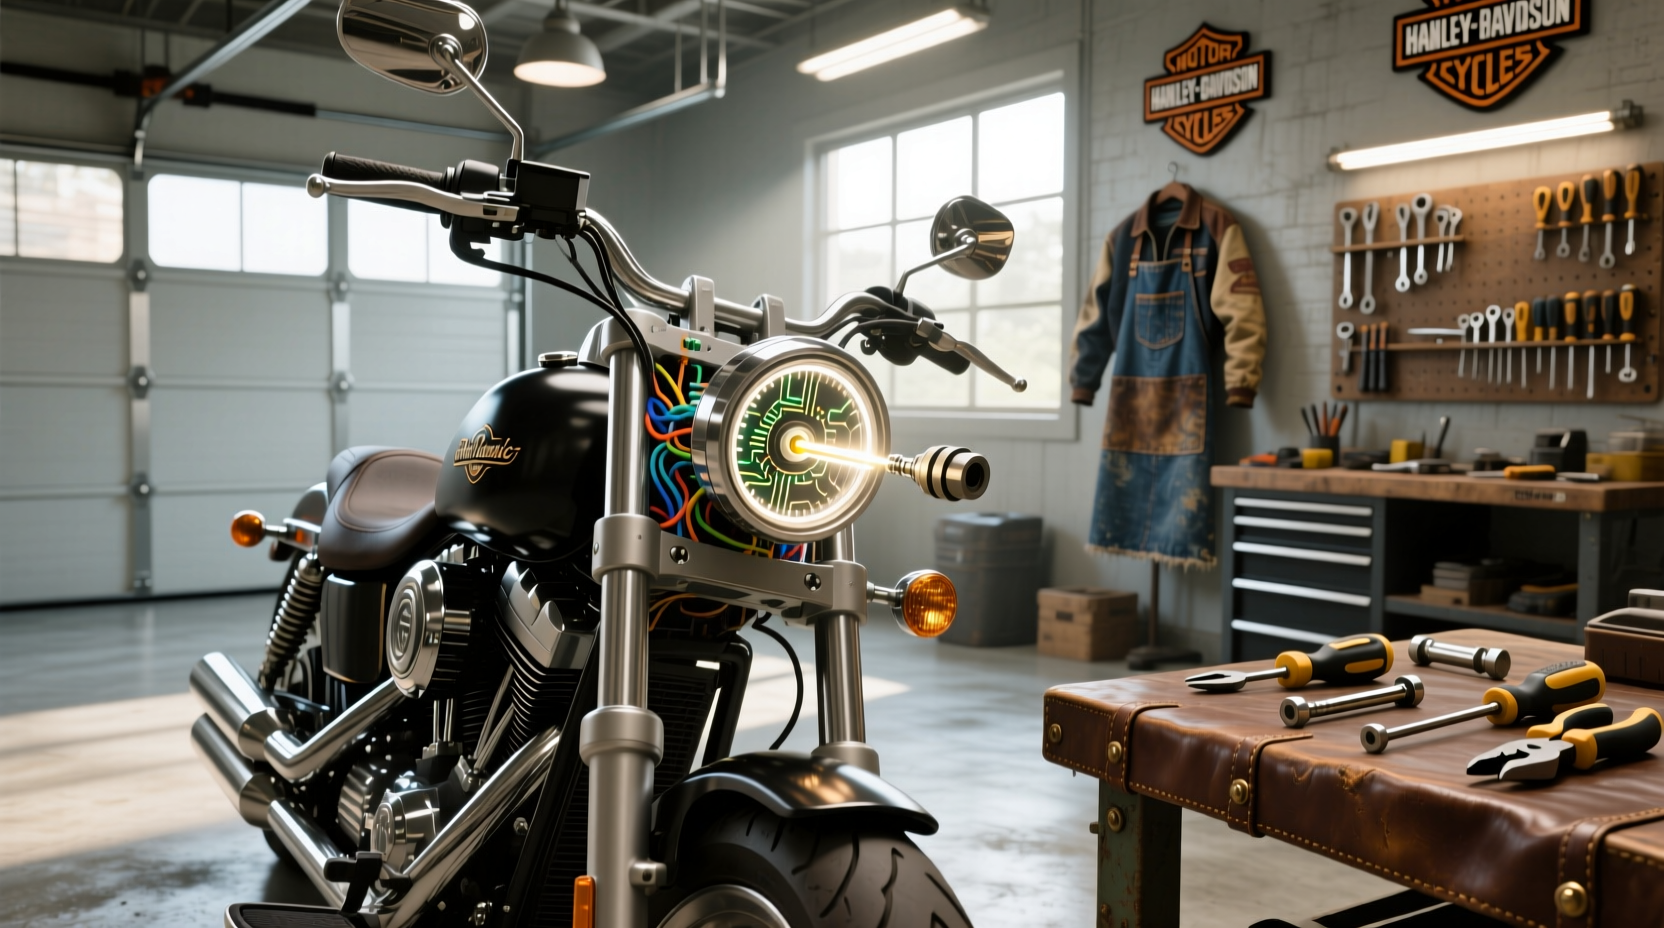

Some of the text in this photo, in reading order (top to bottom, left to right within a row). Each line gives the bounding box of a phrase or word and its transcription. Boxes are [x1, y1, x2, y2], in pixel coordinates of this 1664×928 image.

[1176, 38, 1232, 72] MOTOR
[1440, 45, 1533, 96] CYCLES
[1173, 105, 1235, 144] CYCLES
